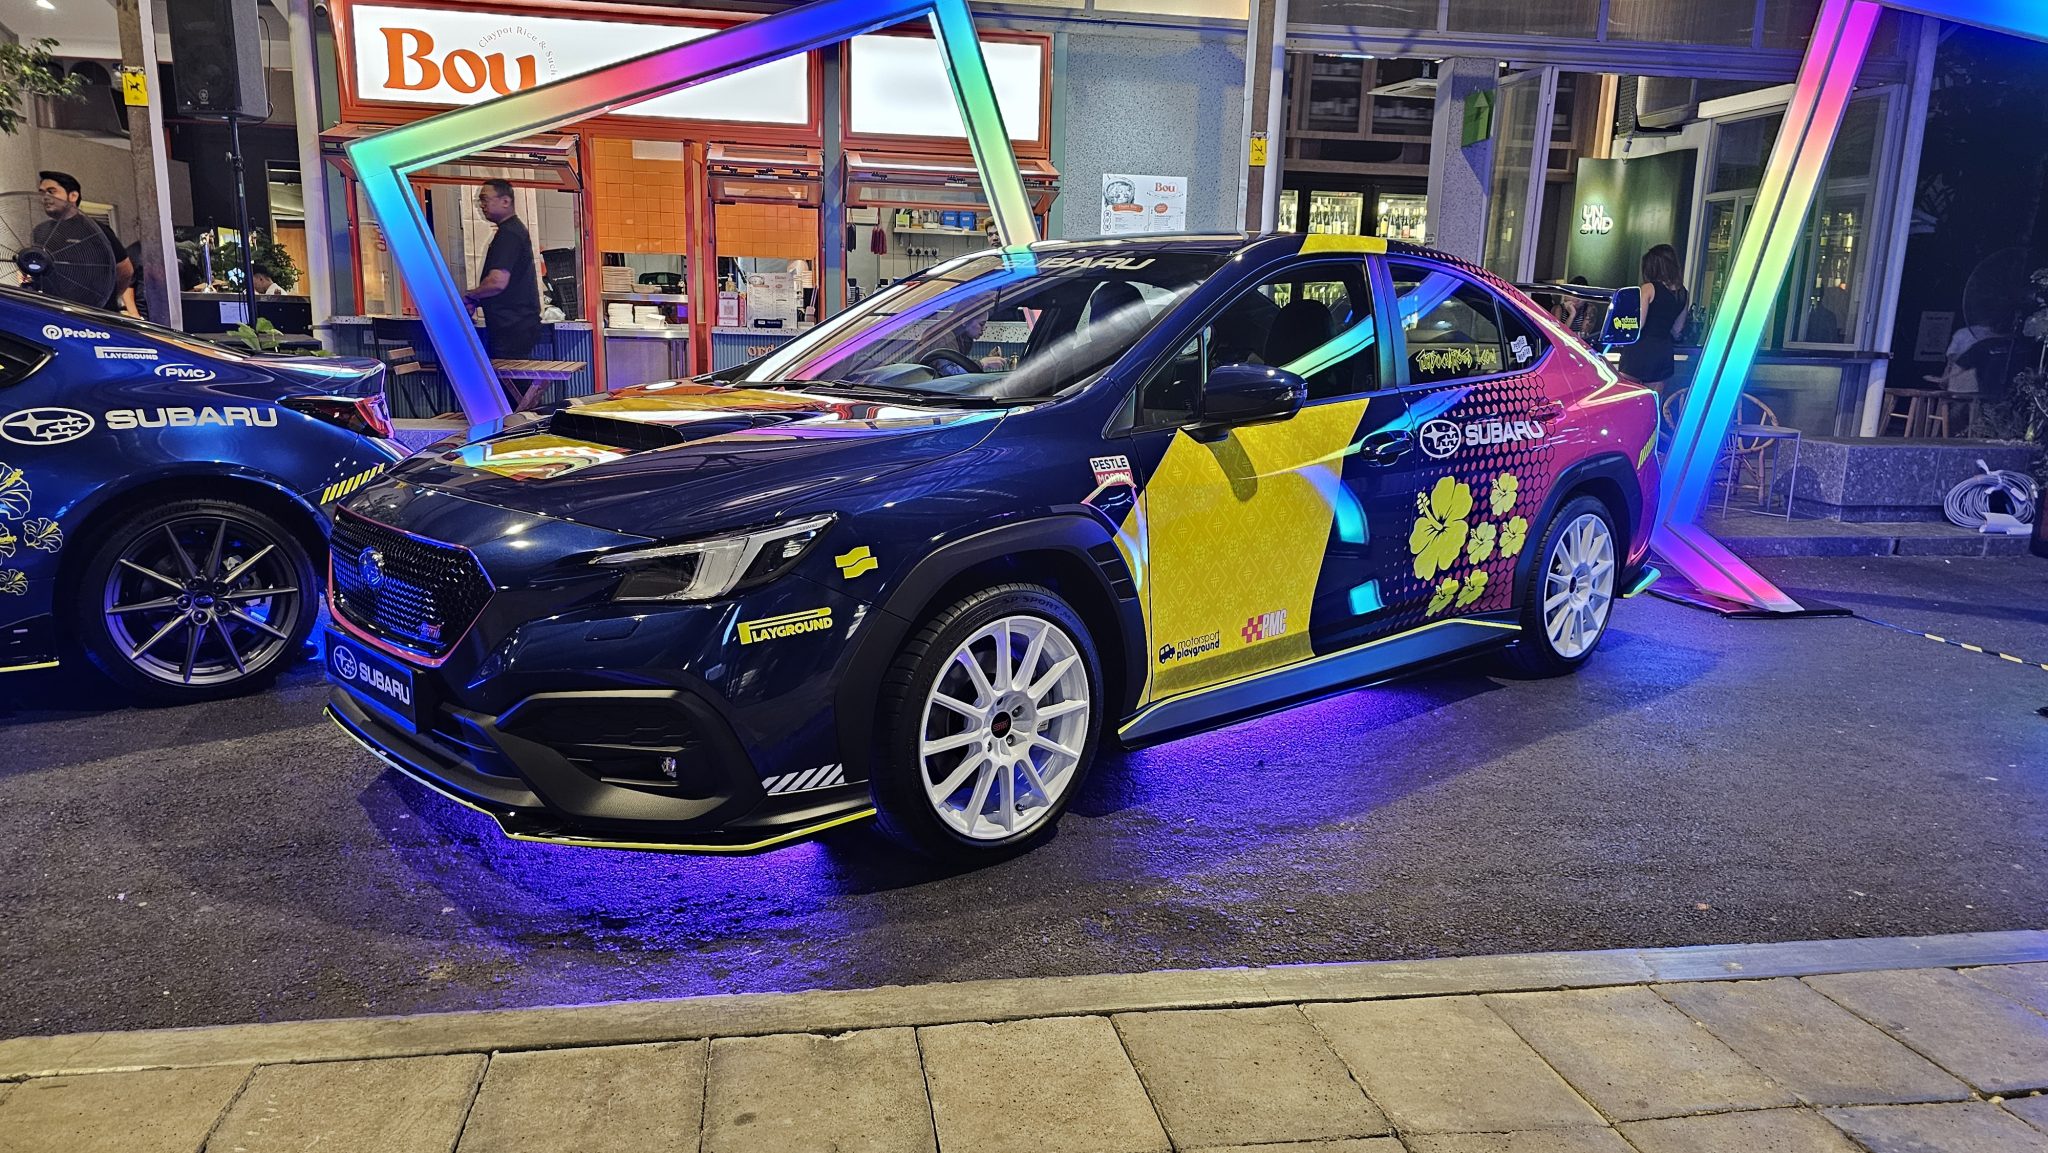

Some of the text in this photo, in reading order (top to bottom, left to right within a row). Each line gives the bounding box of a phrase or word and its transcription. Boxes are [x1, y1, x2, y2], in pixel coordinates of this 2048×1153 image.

[478, 26, 513, 48] Claypot
[516, 26, 538, 42] Rice
[379, 27, 537, 96] Bou
[1155, 182, 1176, 193] Bou
[63, 327, 111, 340] Probro
[94, 346, 159, 360] PLAYGROUND
[165, 367, 206, 379] PMC
[104, 406, 278, 430] SUBARU
[1465, 420, 1545, 446] SUBARU
[1092, 458, 1128, 471] PESTLE
[737, 606, 833, 645] PLAYGROUND
[1262, 609, 1287, 639] PMC
[1177, 629, 1220, 650] motorsport
[1177, 641, 1220, 661] playground
[359, 662, 411, 705] SUBARU
